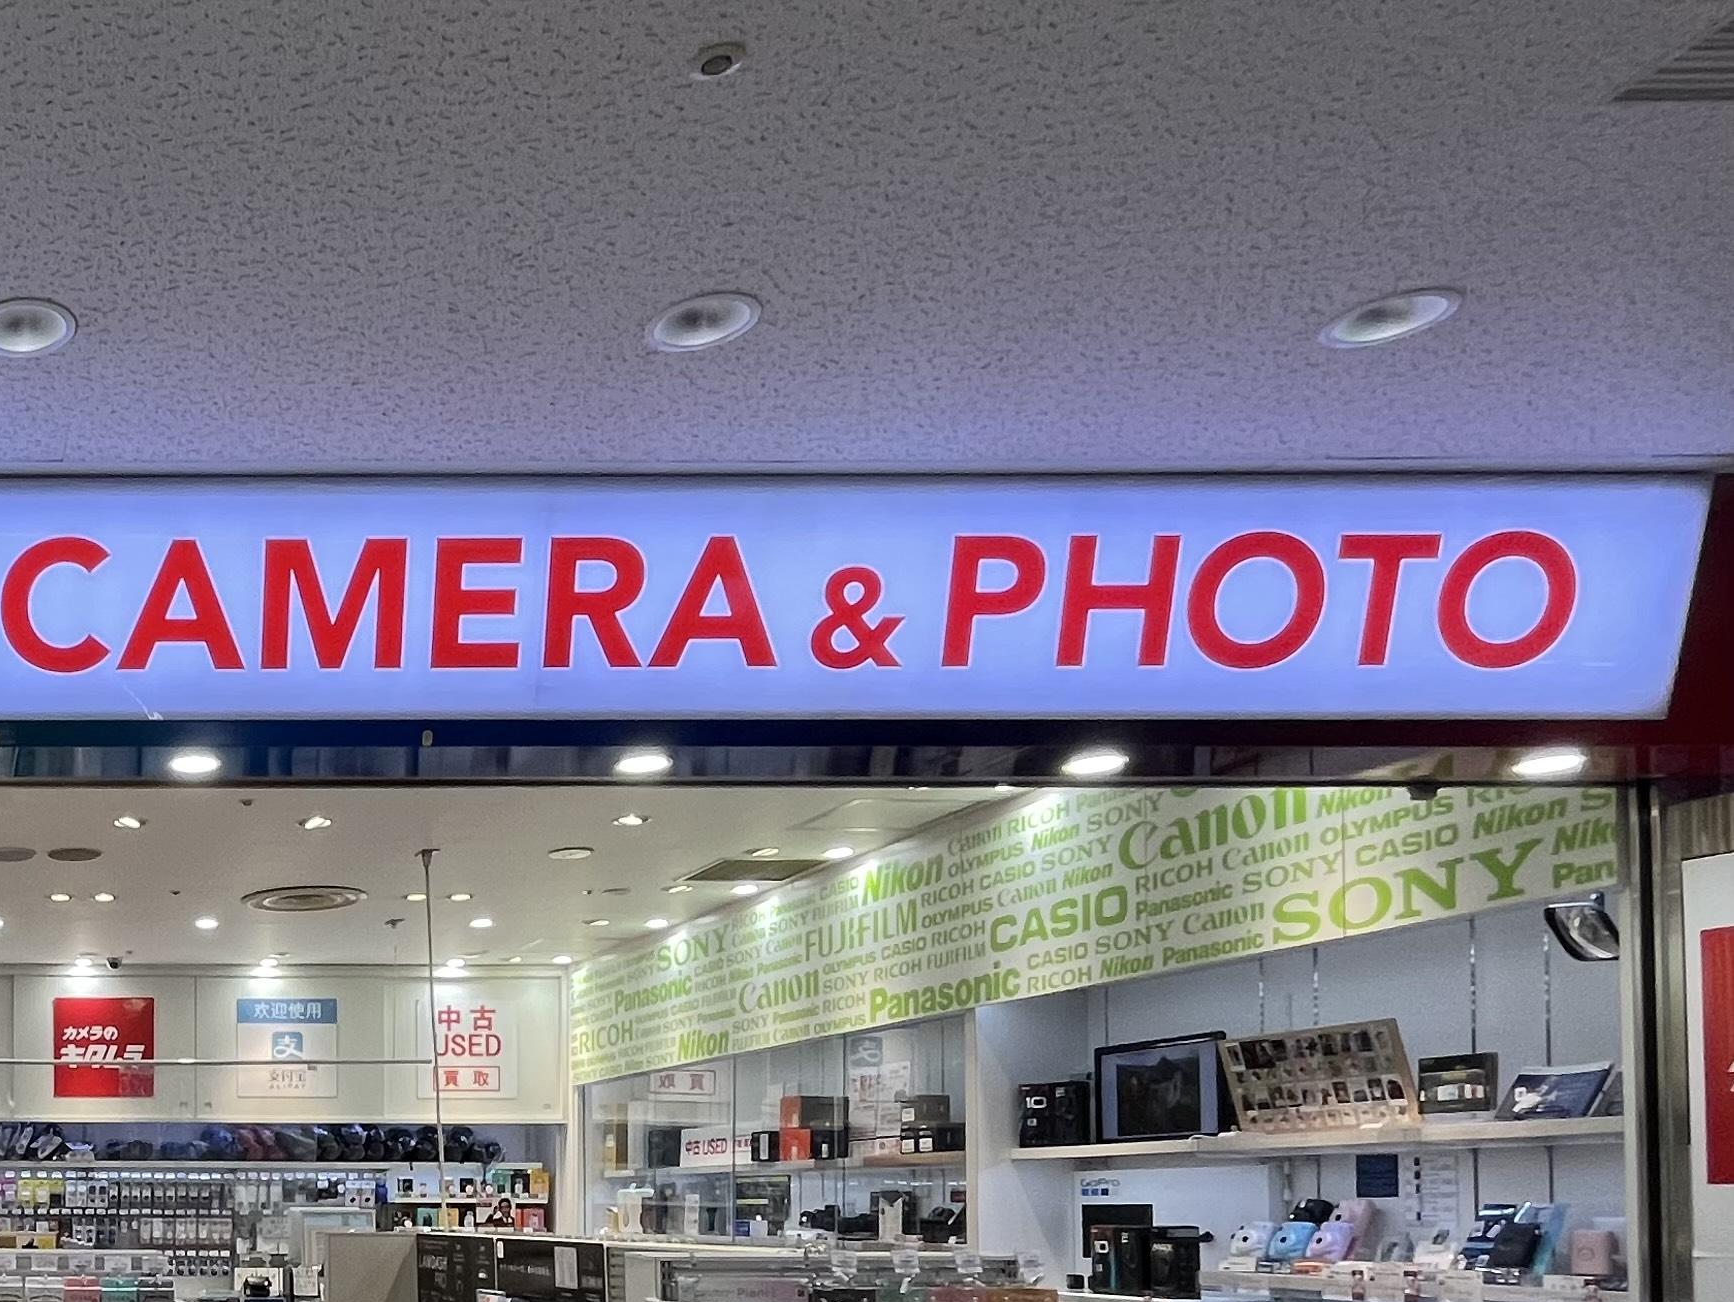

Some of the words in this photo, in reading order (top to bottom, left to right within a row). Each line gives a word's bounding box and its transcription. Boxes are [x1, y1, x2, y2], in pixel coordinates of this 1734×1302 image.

[1, 536, 775, 673] CAMERA
[811, 566, 900, 669] &
[943, 531, 1577, 668] PHOTO
[1008, 801, 1070, 834] RICOH
[1087, 791, 1164, 832] SONY
[1118, 787, 1307, 870] Canon
[1320, 795, 1454, 847] OLYMPUS
[1472, 797, 1568, 839] Nikon
[948, 841, 1024, 878] OLYMPUS
[1030, 824, 1080, 851] Nikon
[1355, 822, 1459, 867] CASIO
[1551, 818, 1617, 856] Nik
[862, 854, 944, 906] Nikon
[921, 879, 974, 908] RICOH
[979, 861, 1035, 891] CASIO
[1040, 833, 1114, 872] SONY
[1135, 856, 1213, 895] RICOH
[1222, 831, 1310, 871] Canon
[1135, 880, 1234, 921] Panasonic
[1242, 848, 1344, 895] SONY
[819, 877, 859, 901] CASIO
[921, 897, 994, 929] OLYMPUS
[998, 877, 1057, 908] Canon
[1062, 863, 1114, 891] Nikon
[1273, 838, 1545, 945] SONY
[769, 911, 811, 937] SONY
[813, 895, 858, 919] FUJIFILM
[805, 898, 917, 962] FUJIFILM
[989, 884, 1128, 953] CASIO
[1095, 919, 1175, 956] SONY
[1183, 902, 1265, 935] Canon
[657, 923, 730, 971] SONY
[726, 945, 764, 968] SONY
[822, 952, 877, 976] OLYMPUS
[881, 937, 927, 960] CASIO
[931, 920, 986, 947] RICOH
[823, 971, 869, 994] SONY
[873, 959, 922, 982] RICOH
[927, 941, 986, 969] FUJIFILM
[1027, 942, 1088, 970] CASIO
[1027, 965, 1092, 994] RICOH
[1099, 954, 1155, 980] Nikon
[1162, 929, 1264, 967] Panasonic
[253, 1001, 322, 1020] 欢迎使用
[614, 969, 693, 1016] Panasonic
[732, 1014, 768, 1035] SONY
[822, 991, 866, 1014] RICOH
[739, 969, 820, 1014] Canon
[870, 961, 1021, 1024] Panasonic
[62, 1025, 119, 1041] カメラの
[437, 1004, 496, 1032] 中古
[578, 1019, 635, 1055] RICOH
[813, 1014, 866, 1034] OLYMPUS
[59, 1044, 146, 1069] キタムラ
[436, 1034, 502, 1057] USED
[677, 1029, 730, 1062] Nikon
[1025, 1096, 1047, 1109] 10
[703, 1137, 728, 1155] USED
[1080, 1178, 1120, 1188] GoPro
